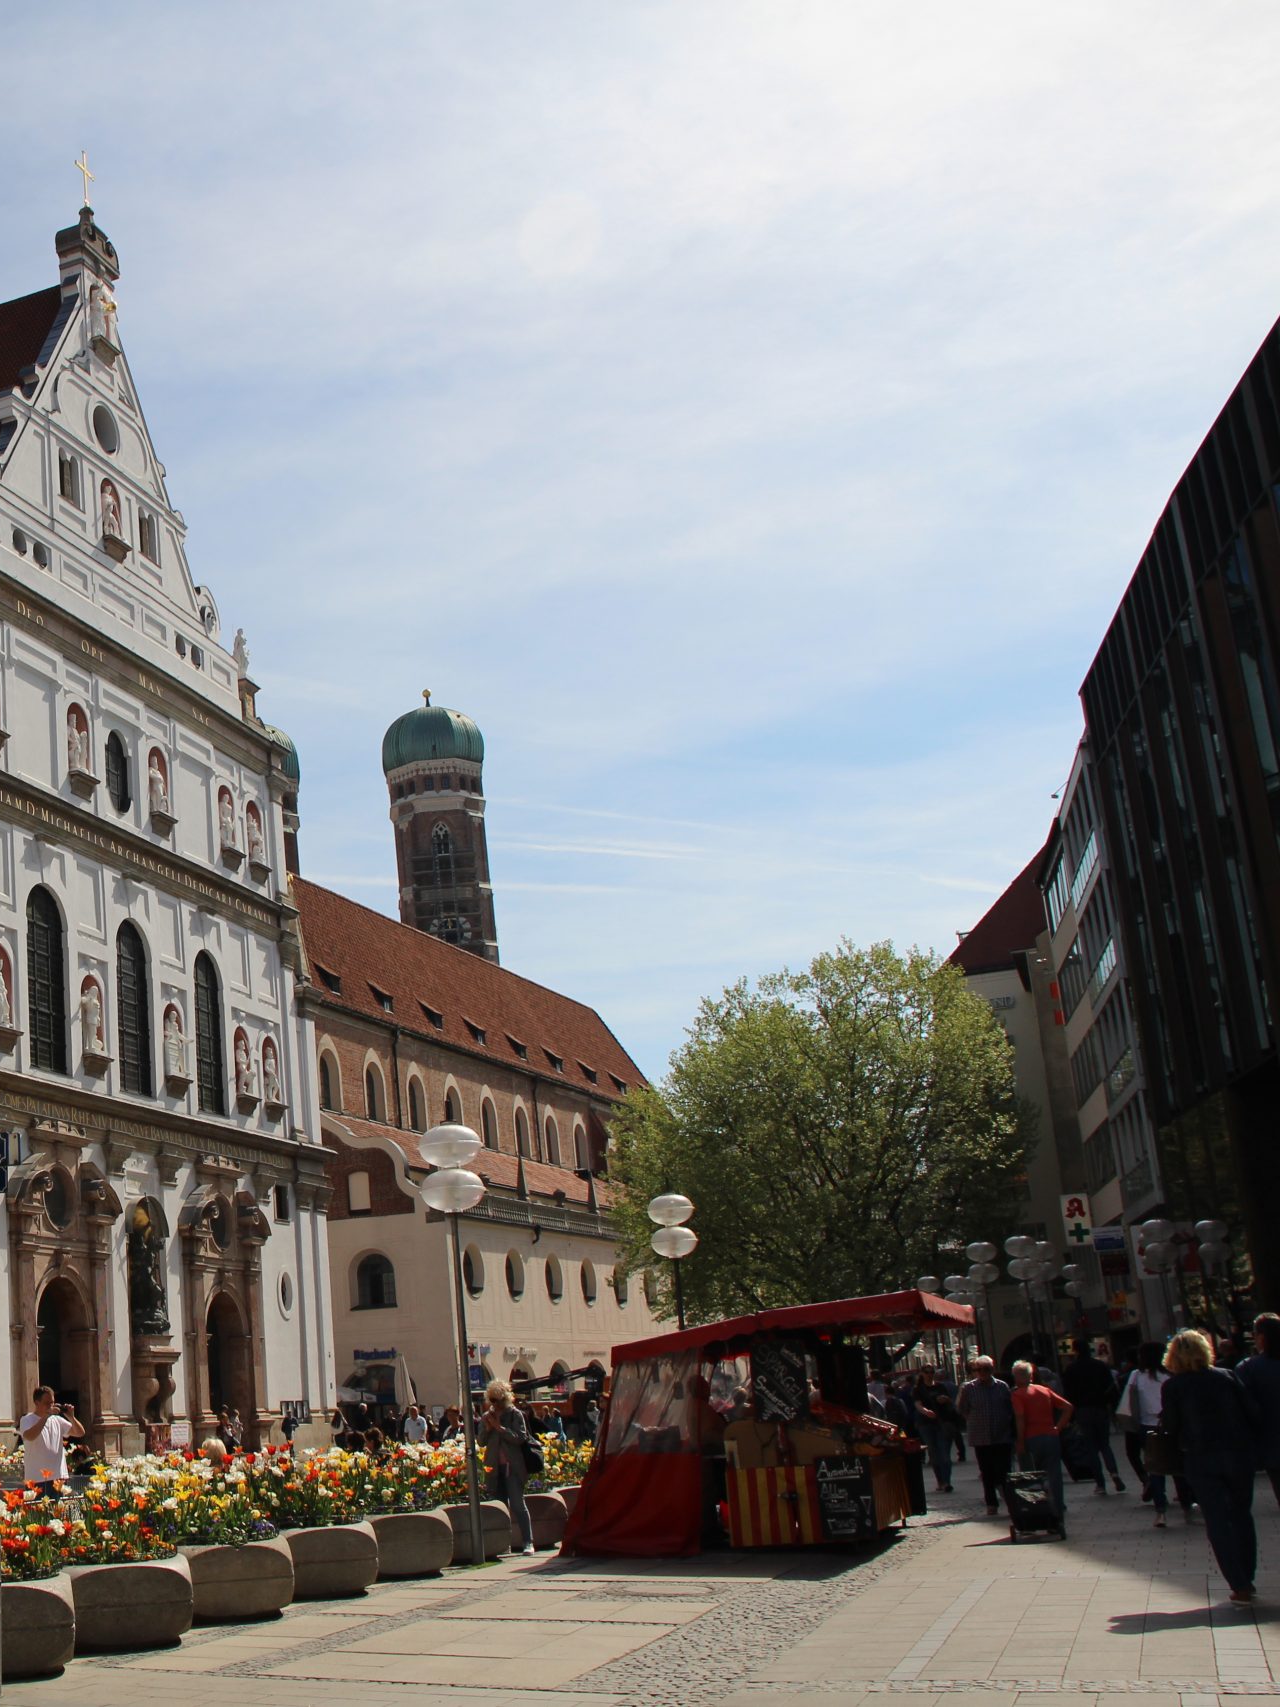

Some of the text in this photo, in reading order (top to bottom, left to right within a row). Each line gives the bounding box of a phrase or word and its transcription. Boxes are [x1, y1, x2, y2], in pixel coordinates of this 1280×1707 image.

[17, 600, 43, 626] DEO
[41, 807, 105, 848] MICHAELIS
[110, 841, 180, 883] ARCHANGELI
